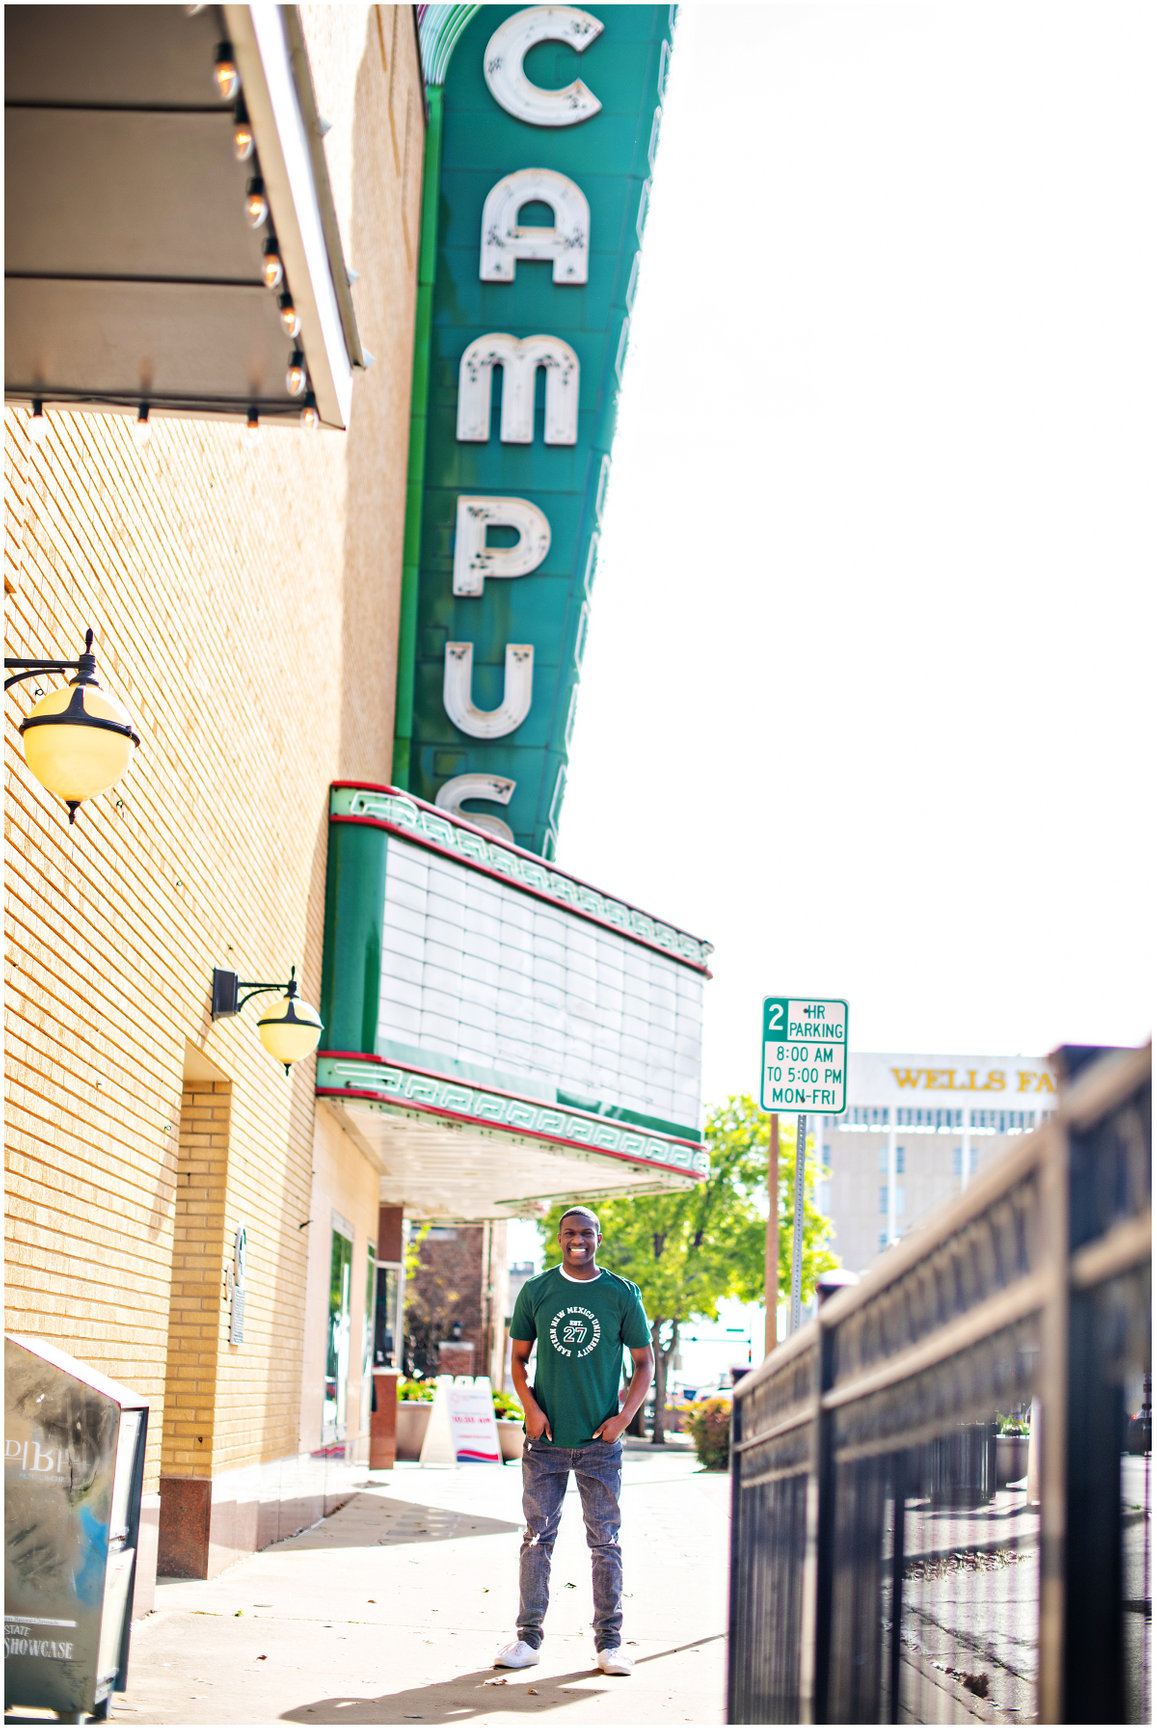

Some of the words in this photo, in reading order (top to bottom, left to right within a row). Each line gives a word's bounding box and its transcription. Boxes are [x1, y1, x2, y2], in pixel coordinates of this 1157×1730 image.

[435, 5, 604, 843] CAMPUS
[768, 1003, 784, 1030] 2
[807, 1004, 826, 1020] HR
[789, 1022, 843, 1039] PARKING
[776, 1046, 809, 1062] 8:00
[814, 1047, 833, 1063] AM
[767, 1066, 782, 1082] TO
[788, 1067, 819, 1083] 5:00
[824, 1068, 842, 1084] PM
[891, 1068, 1006, 1091] WELLS
[1016, 1071, 1056, 1094] FA
[772, 1087, 836, 1105] MON-FRI
[550, 1309, 566, 1327] NEW
[566, 1306, 595, 1320] MEXICO
[549, 1328, 572, 1357] EASTERN
[563, 1325, 588, 1344] 27
[577, 1318, 601, 1358] UNIVERSITY
